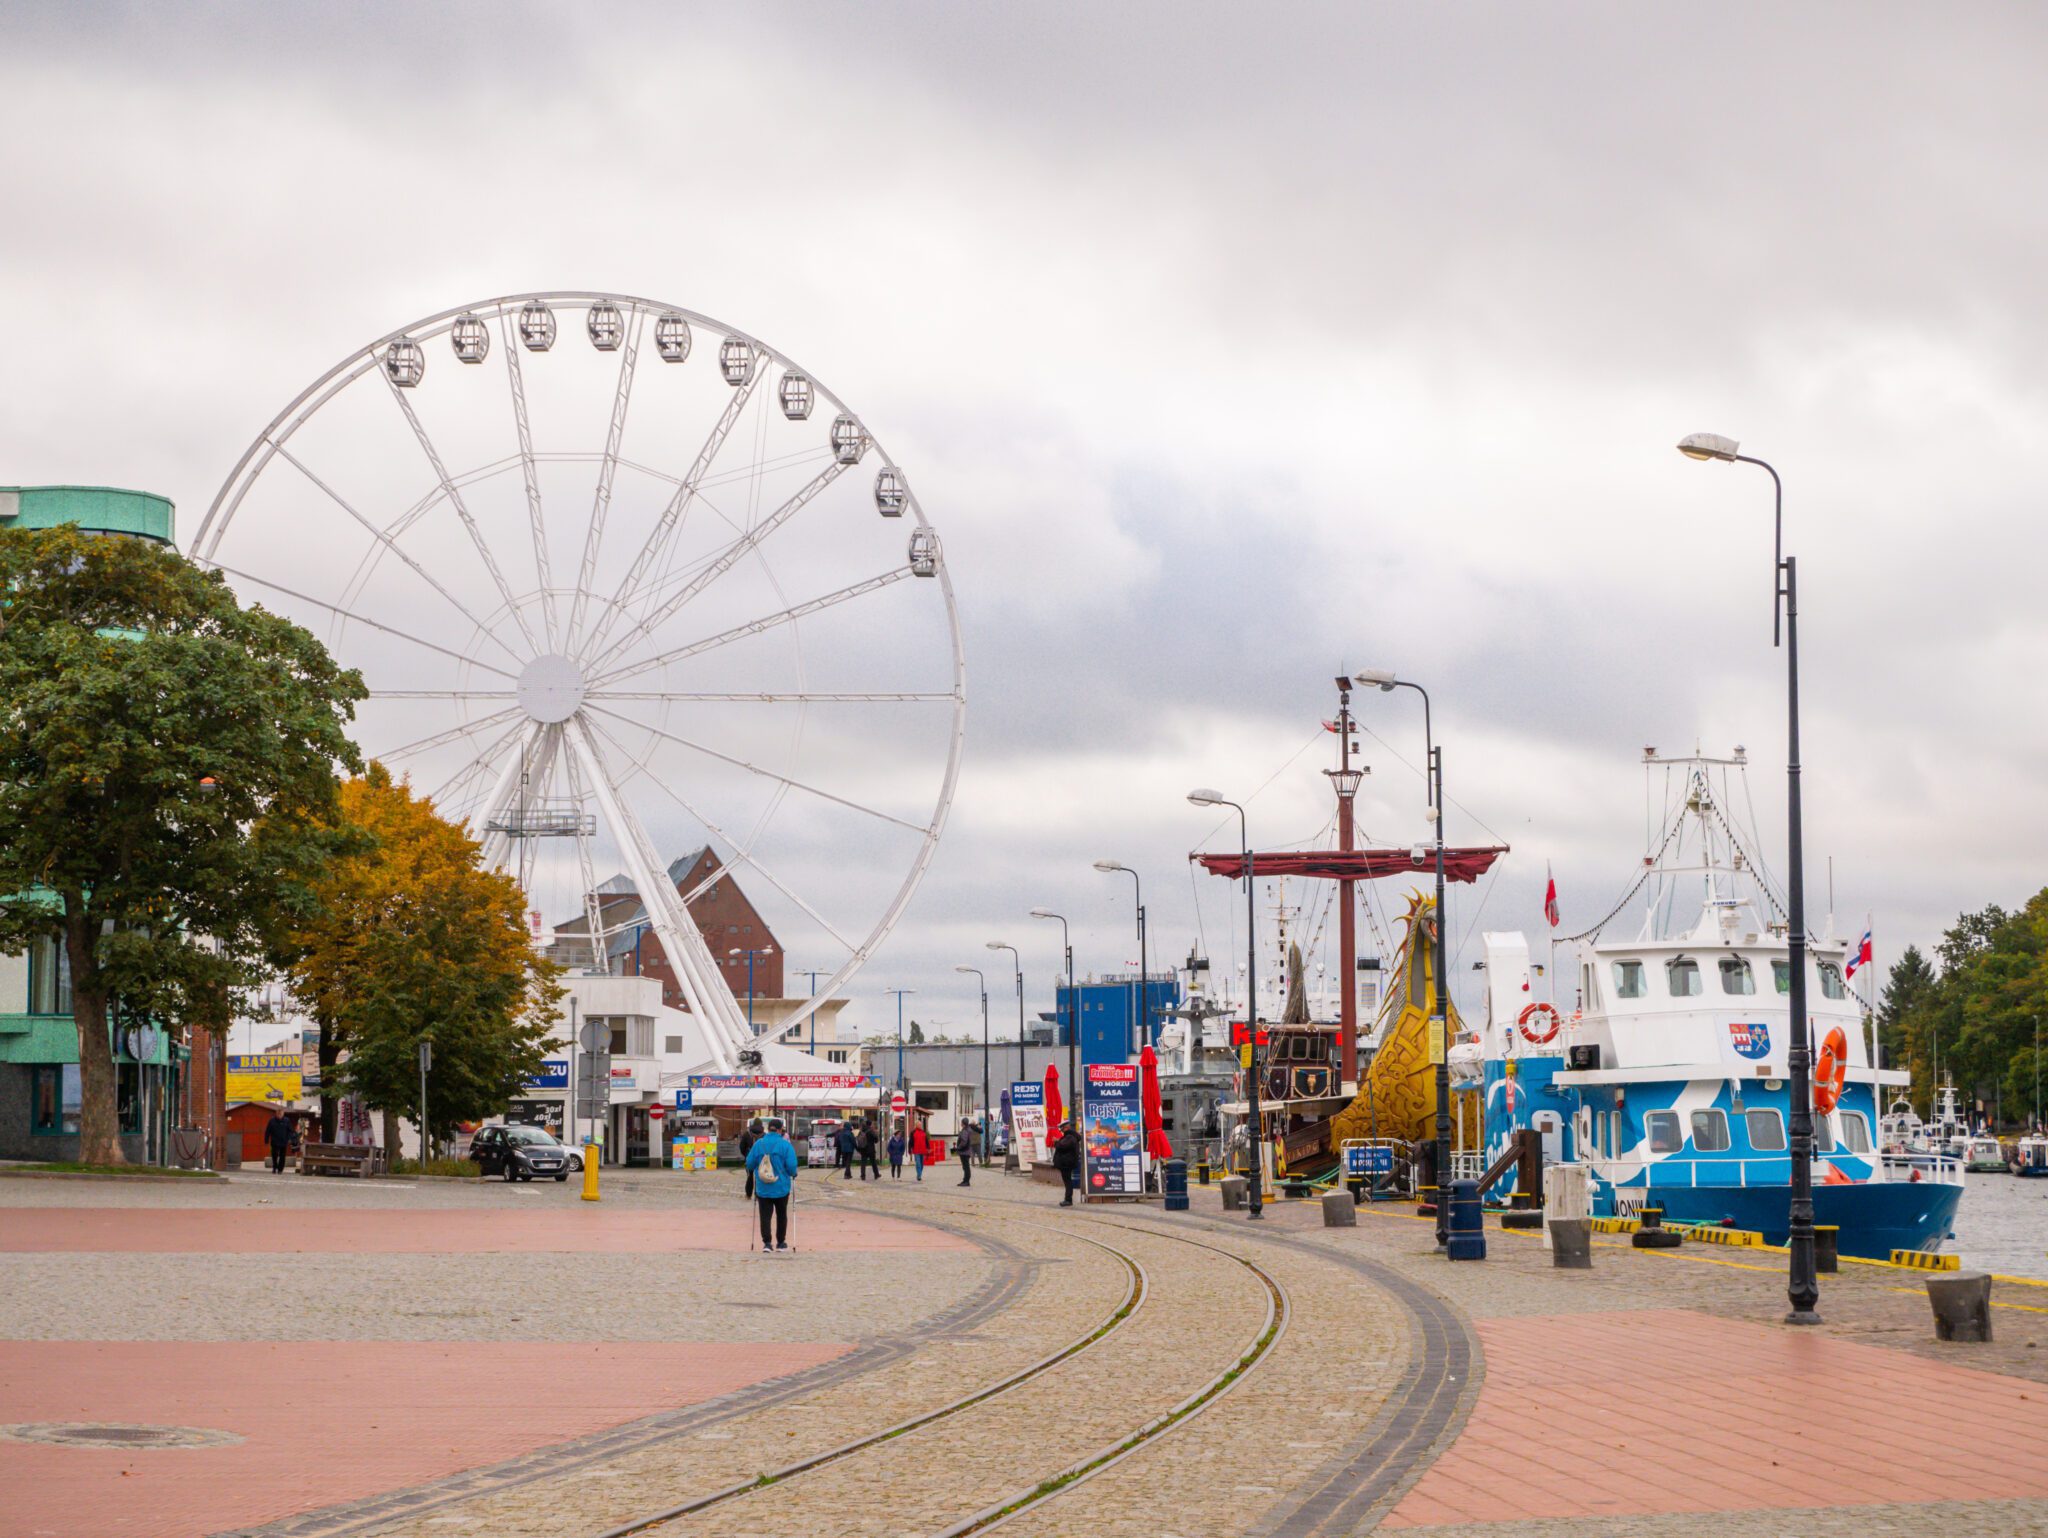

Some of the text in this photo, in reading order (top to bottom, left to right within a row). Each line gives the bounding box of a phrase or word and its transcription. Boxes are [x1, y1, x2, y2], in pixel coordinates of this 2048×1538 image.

[240, 1055, 301, 1068] BASTION
[1014, 1085, 1041, 1093] REJSY
[680, 1092, 688, 1104] P
[1089, 1104, 1120, 1119] Rejsy
